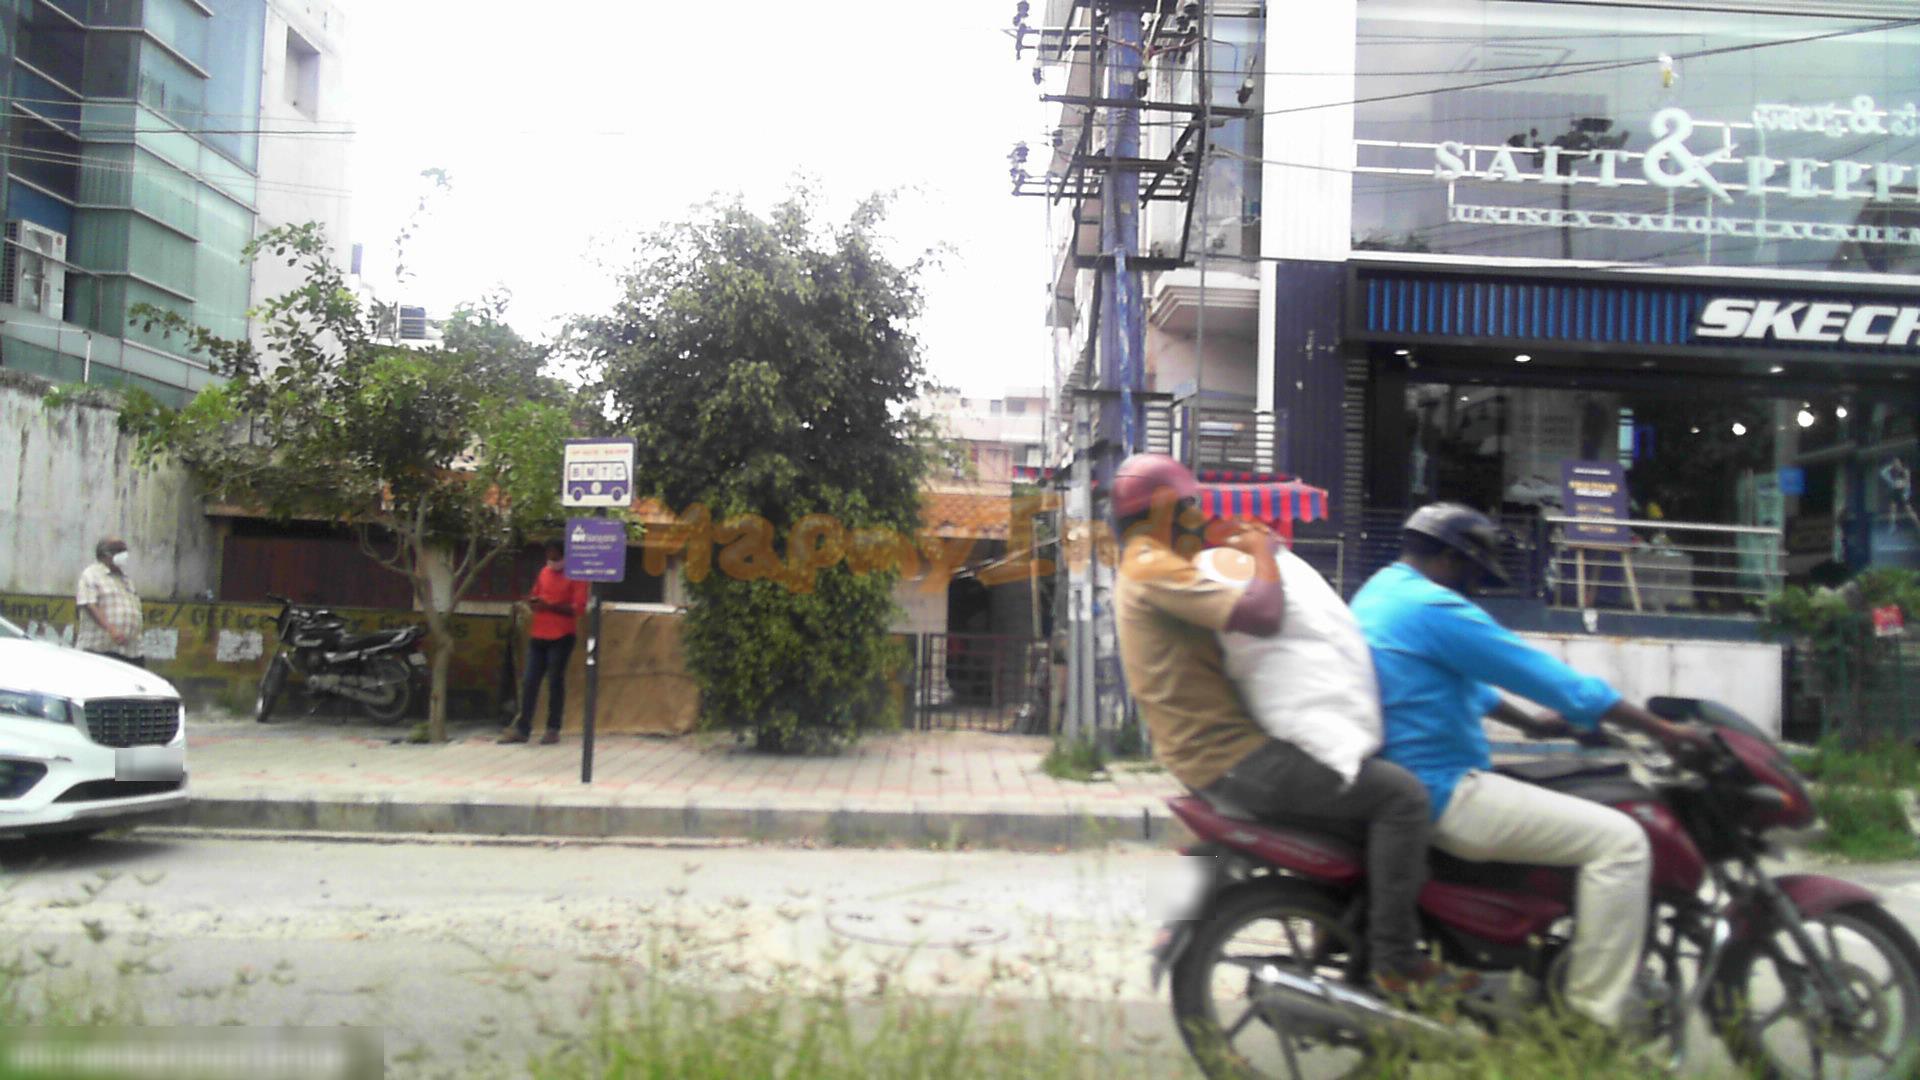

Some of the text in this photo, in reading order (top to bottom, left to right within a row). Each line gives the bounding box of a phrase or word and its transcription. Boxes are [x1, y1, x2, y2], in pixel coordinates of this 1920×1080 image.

[1435, 107, 1919, 204] SALT & PEPP
[1613, 211, 1735, 235] SALON
